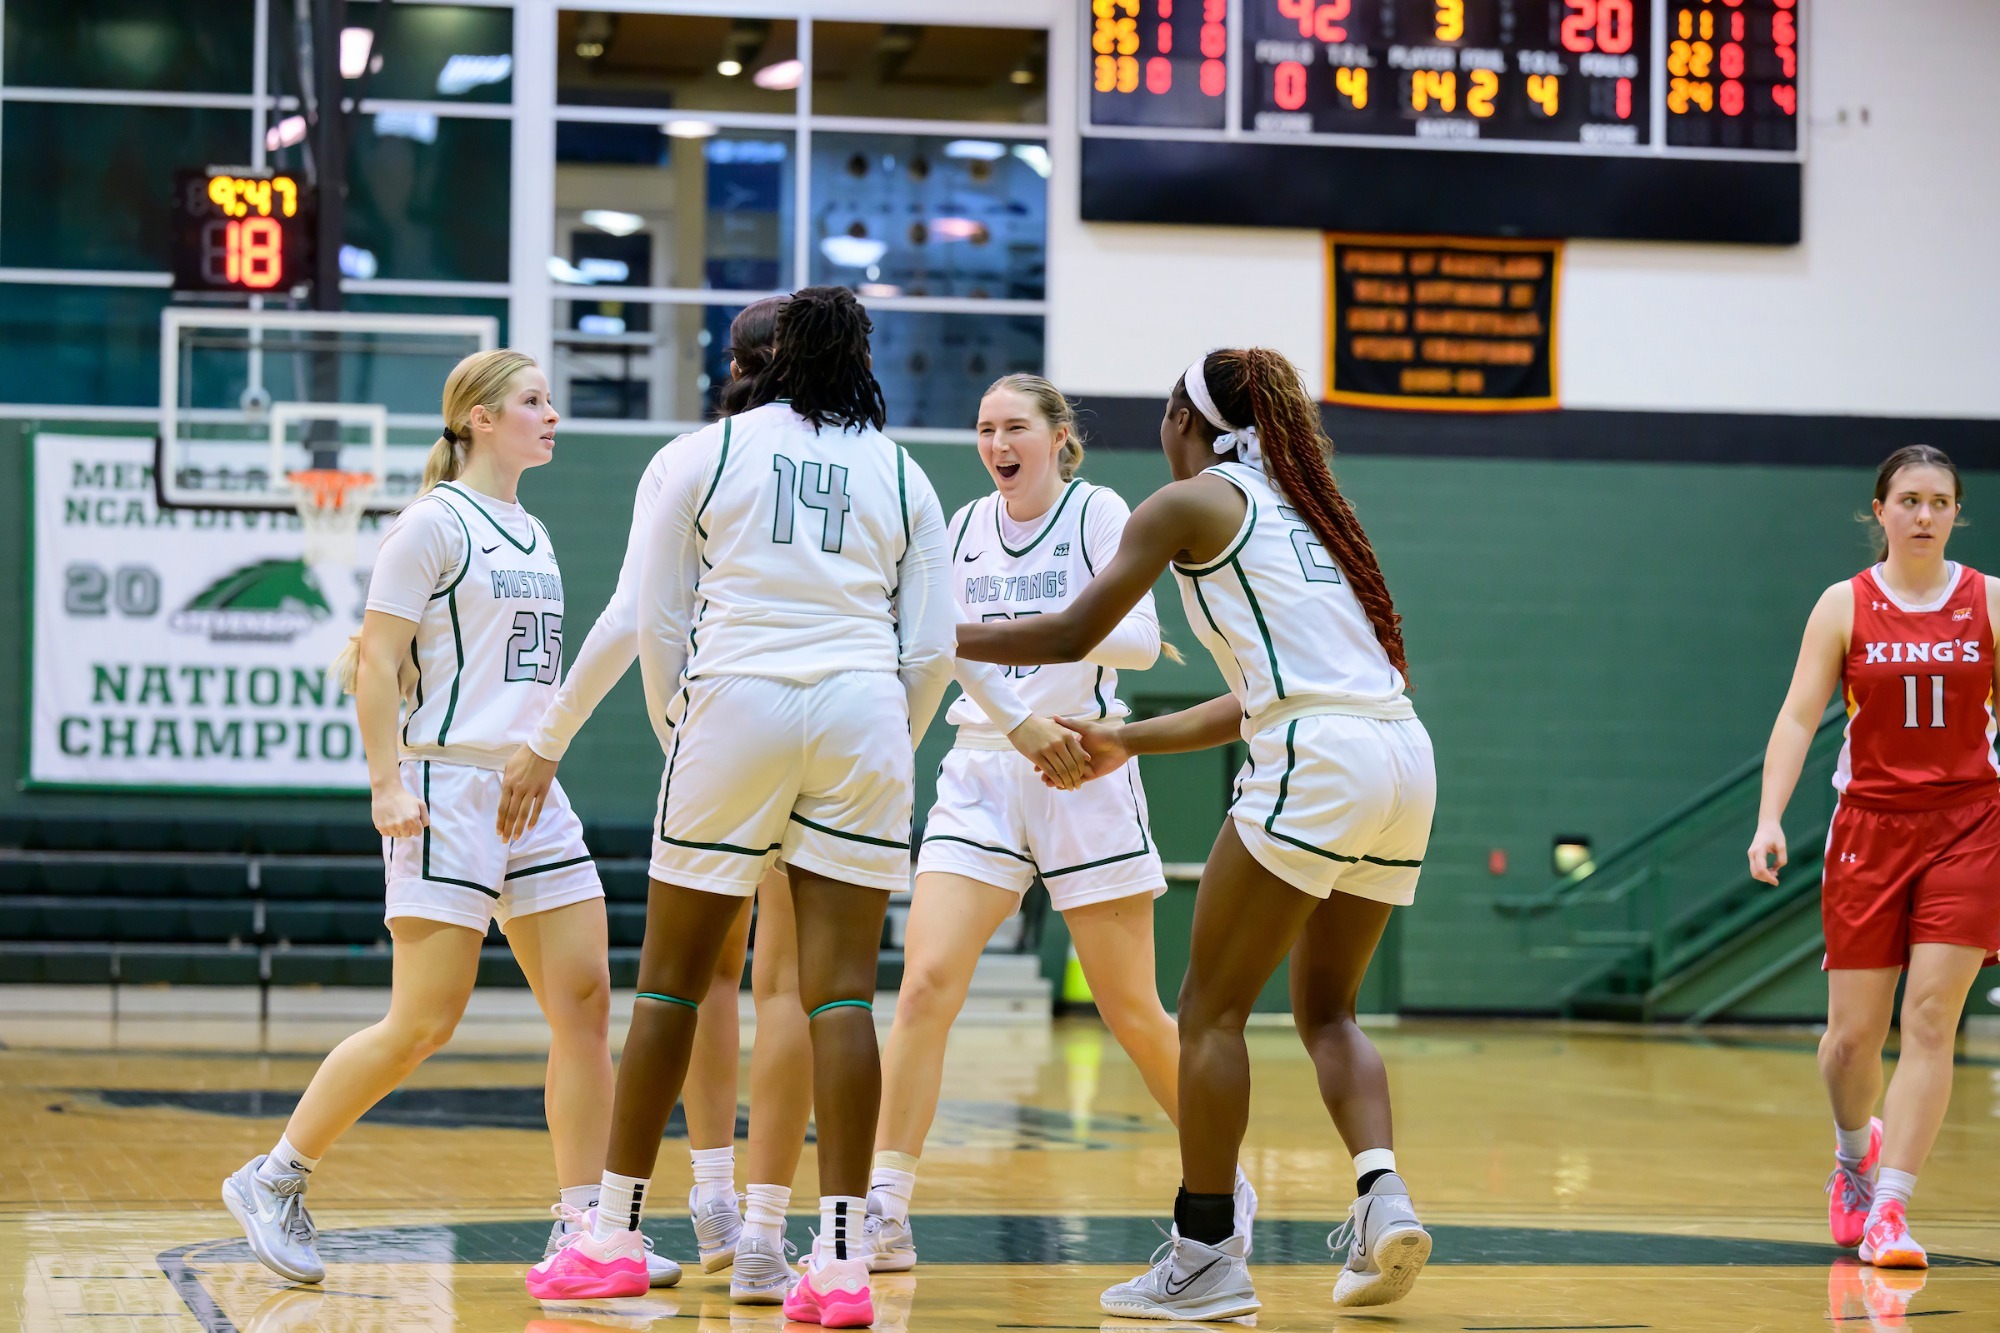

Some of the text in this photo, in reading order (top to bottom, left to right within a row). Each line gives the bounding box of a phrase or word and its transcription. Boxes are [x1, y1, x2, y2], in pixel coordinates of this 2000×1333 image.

[1158, 22, 1172, 54] 1
[1278, 0, 1351, 42] 42
[1435, 0, 1464, 41] 3
[1561, 0, 1633, 53] 20
[1679, 9, 1713, 40] 11
[1731, 11, 1744, 41] 1
[1720, 42, 1744, 78] 0
[1775, 45, 1796, 78] 7
[1274, 61, 1307, 110] 0
[1336, 67, 1368, 109] 4
[1412, 70, 1456, 112] 14
[1467, 69, 1499, 117] 2
[1527, 74, 1558, 117] 4
[1616, 78, 1632, 119] 1
[1720, 80, 1744, 116] 0
[1772, 84, 1796, 115] 4
[208, 175, 297, 217] 9:47
[226, 216, 282, 288] 18
[65, 499, 177, 528] NCAA
[772, 453, 850, 554] 14
[64, 563, 160, 614] 20
[965, 570, 1067, 604] MUSTANGS
[504, 611, 563, 685] 25
[1865, 639, 1980, 664] KING'S
[1901, 674, 1946, 728] 11
